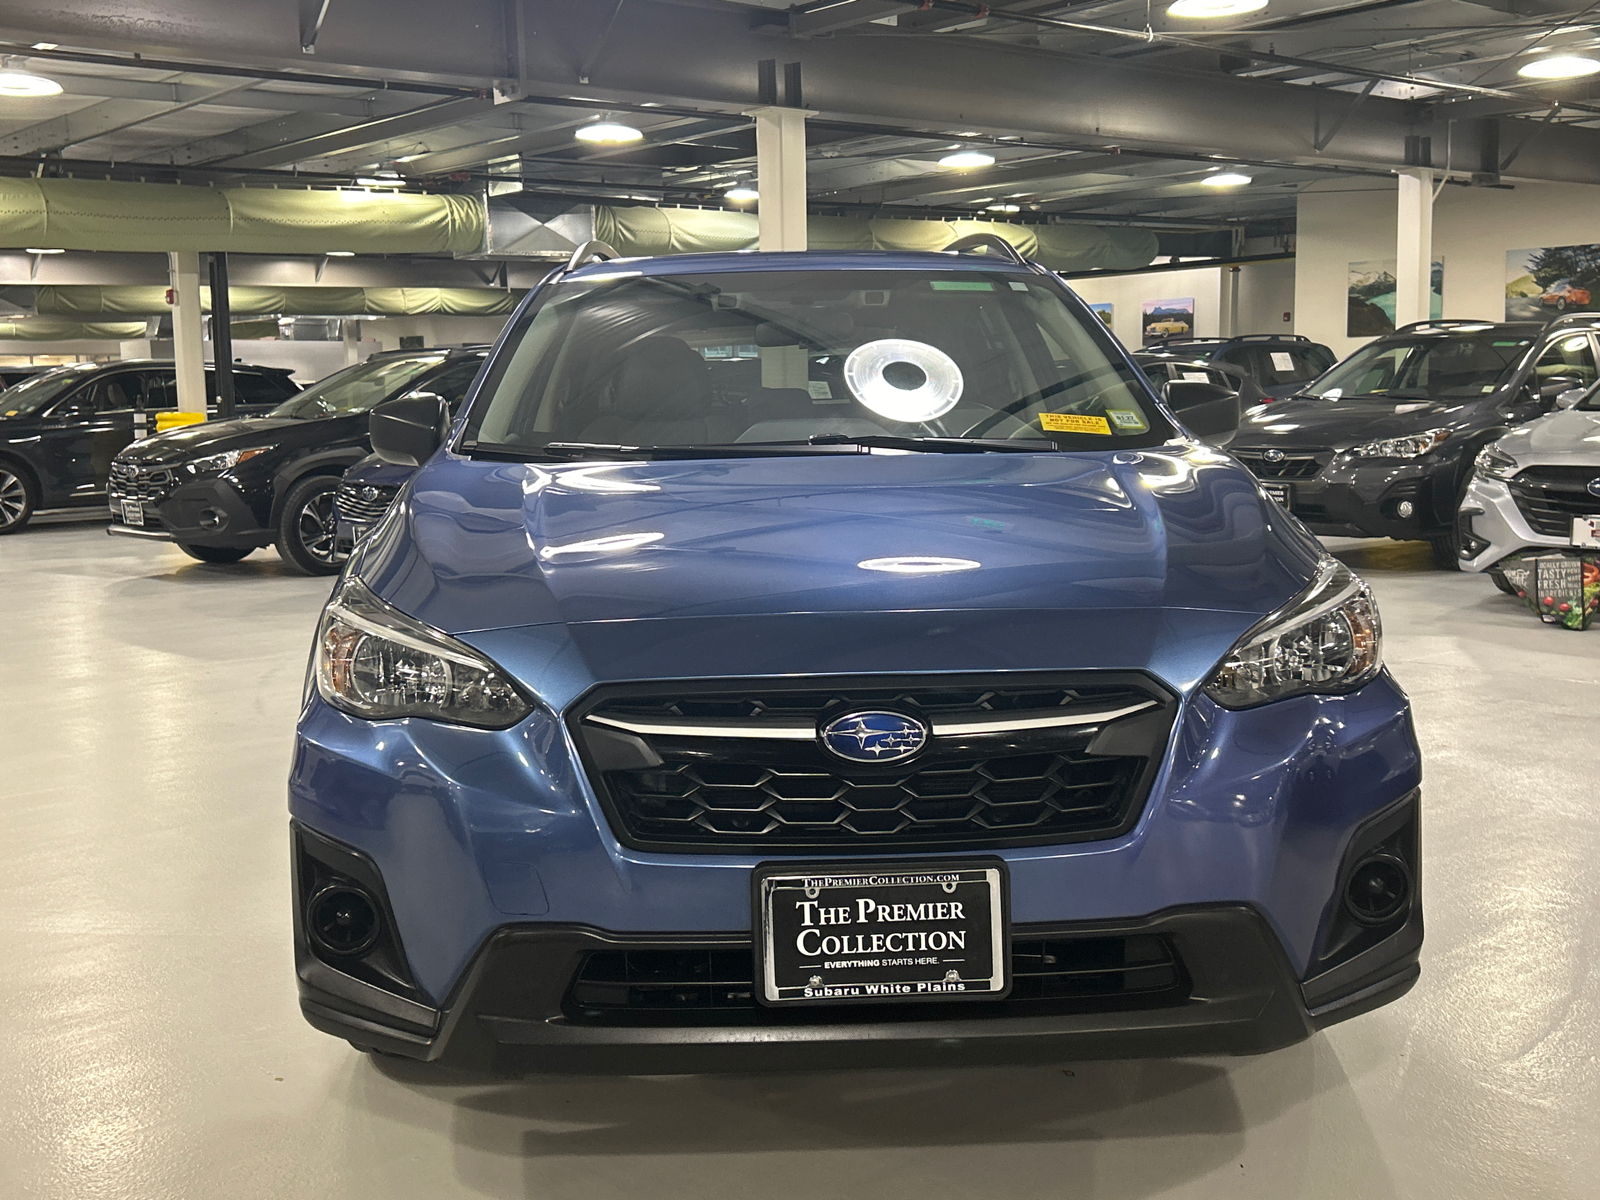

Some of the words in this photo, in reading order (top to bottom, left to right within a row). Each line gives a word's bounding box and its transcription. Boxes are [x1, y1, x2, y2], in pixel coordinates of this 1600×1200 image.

[1538, 569, 1566, 580] TASTY
[1538, 579, 1566, 589] FRESH
[796, 900, 851, 926] THE
[856, 898, 966, 925] PREMIER
[796, 928, 966, 956] COLLECTION
[824, 959, 880, 969] EVERYTHING
[881, 958, 913, 967] STARTS
[914, 957, 940, 966] HERE.
[803, 986, 860, 998] Subaru
[865, 983, 911, 995] White
[917, 980, 966, 993] Plains
